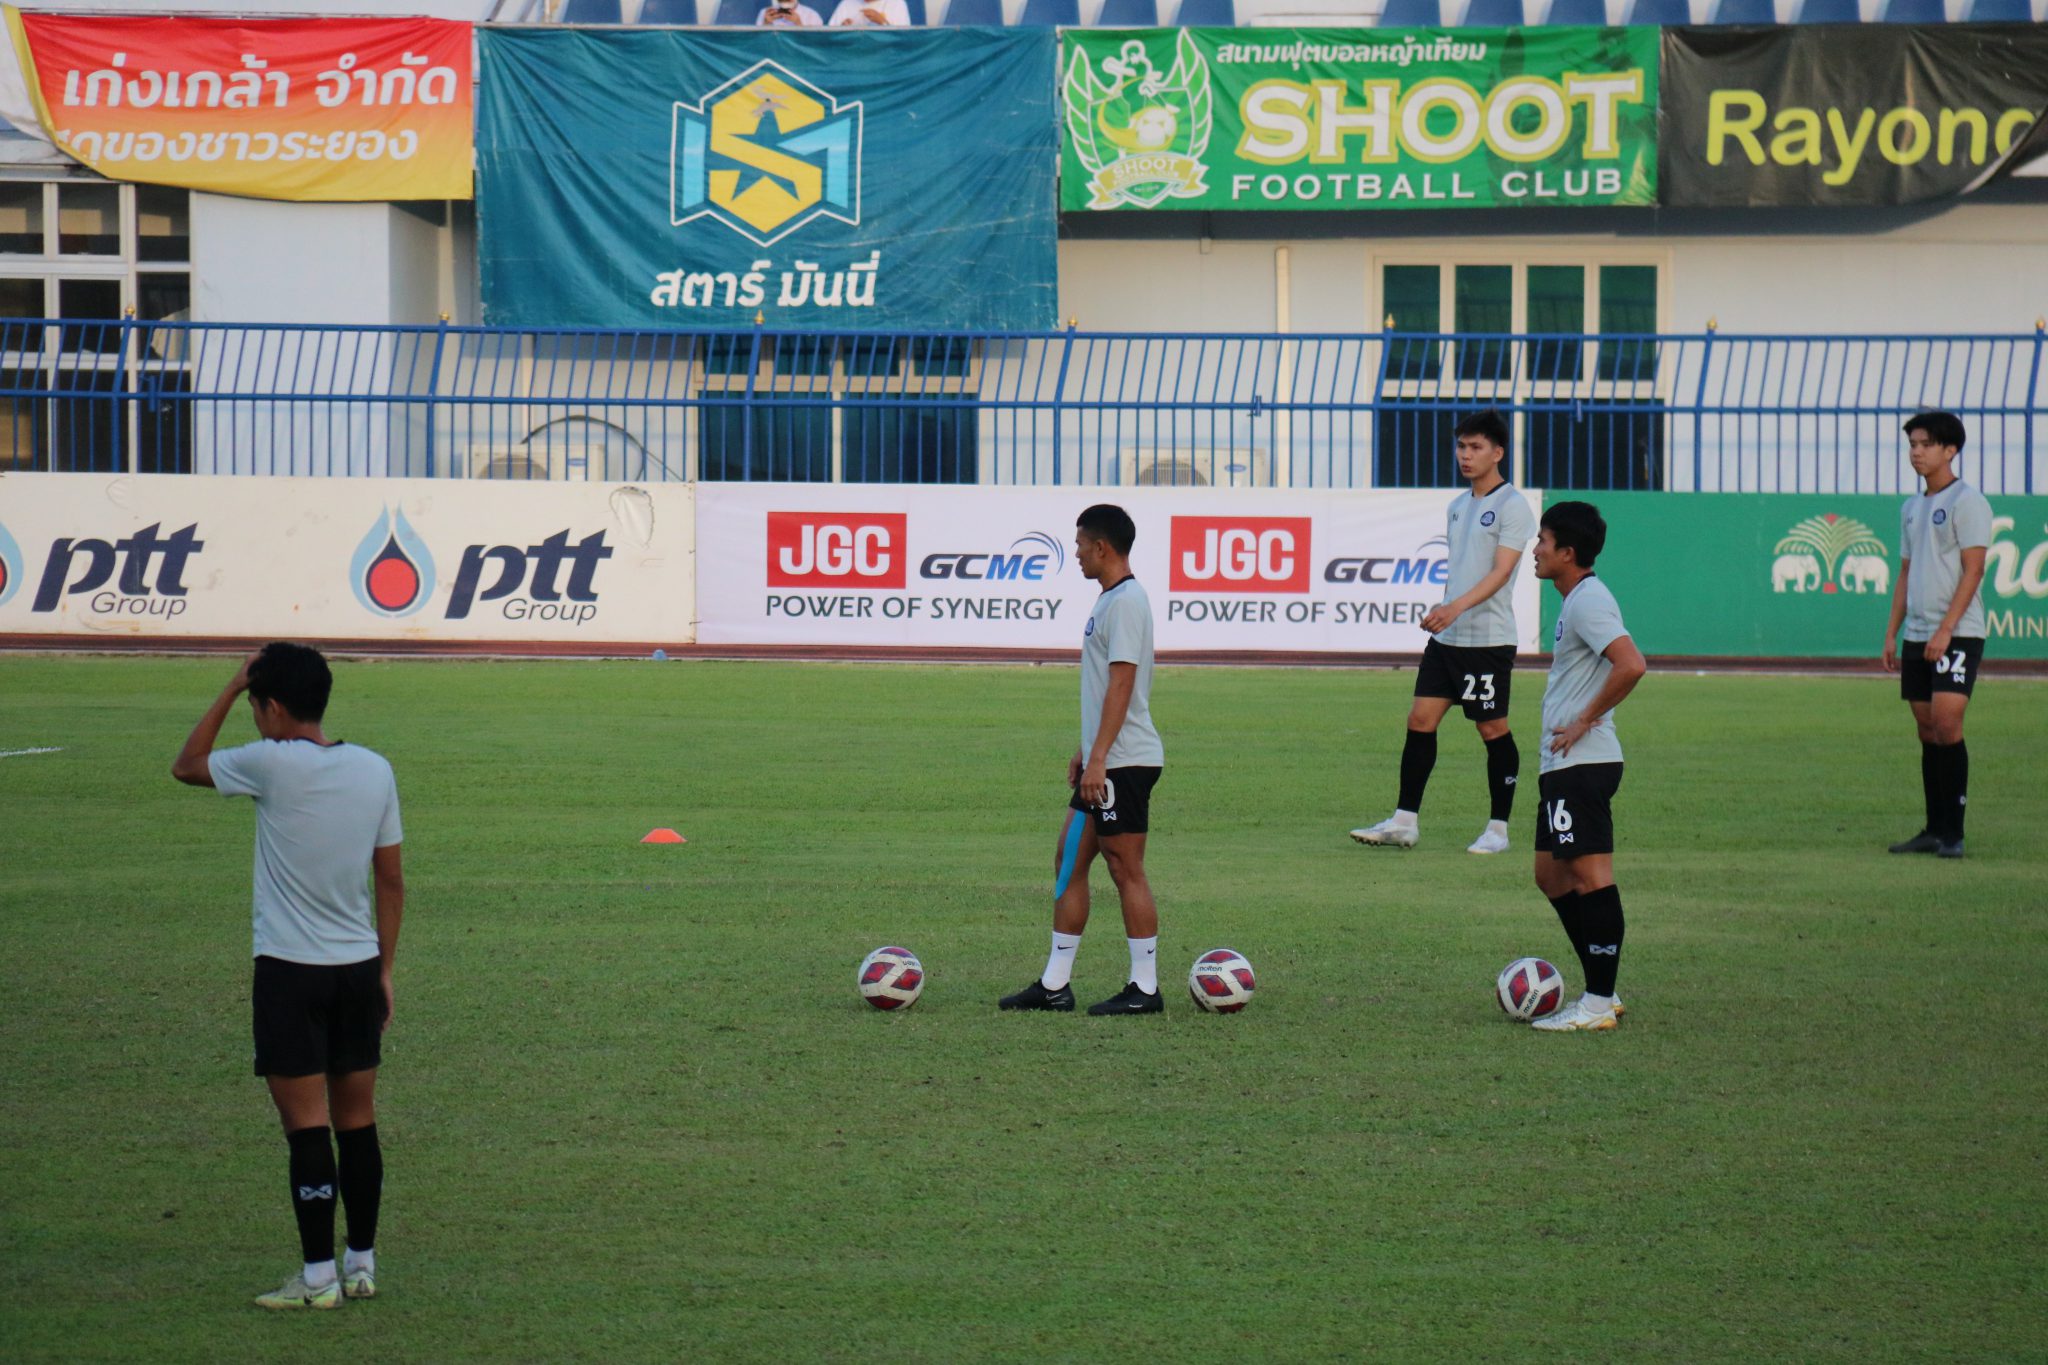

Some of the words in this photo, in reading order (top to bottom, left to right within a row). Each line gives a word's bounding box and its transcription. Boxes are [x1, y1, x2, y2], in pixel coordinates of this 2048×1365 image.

[1216, 36, 1487, 71] สนามฟุตบอลหญ้าเทียม
[62, 52, 290, 108] เก่งเกล้า
[316, 52, 457, 107] จำกัด
[1236, 69, 1643, 166] SHOOT
[1231, 173, 1475, 201] FOOTBALL
[1501, 168, 1622, 198] CLUB
[650, 259, 772, 307] สตาร์
[777, 249, 881, 307] มันนี่
[32, 521, 205, 612] ptt
[779, 524, 891, 577] JGC
[919, 553, 1050, 581] GCME
[1182, 528, 1295, 581] JGC
[444, 528, 615, 620] ptt
[91, 591, 187, 620] Group
[503, 598, 597, 626] Group
[766, 595, 873, 618] POWER
[883, 597, 921, 618] OF
[931, 597, 1063, 620] SYNERGY
[1167, 600, 1277, 623] POWER
[1285, 601, 1326, 623] OF
[1985, 609, 2048, 638] MIN
[1462, 673, 1496, 700] 23
[1546, 799, 1573, 834] 16
